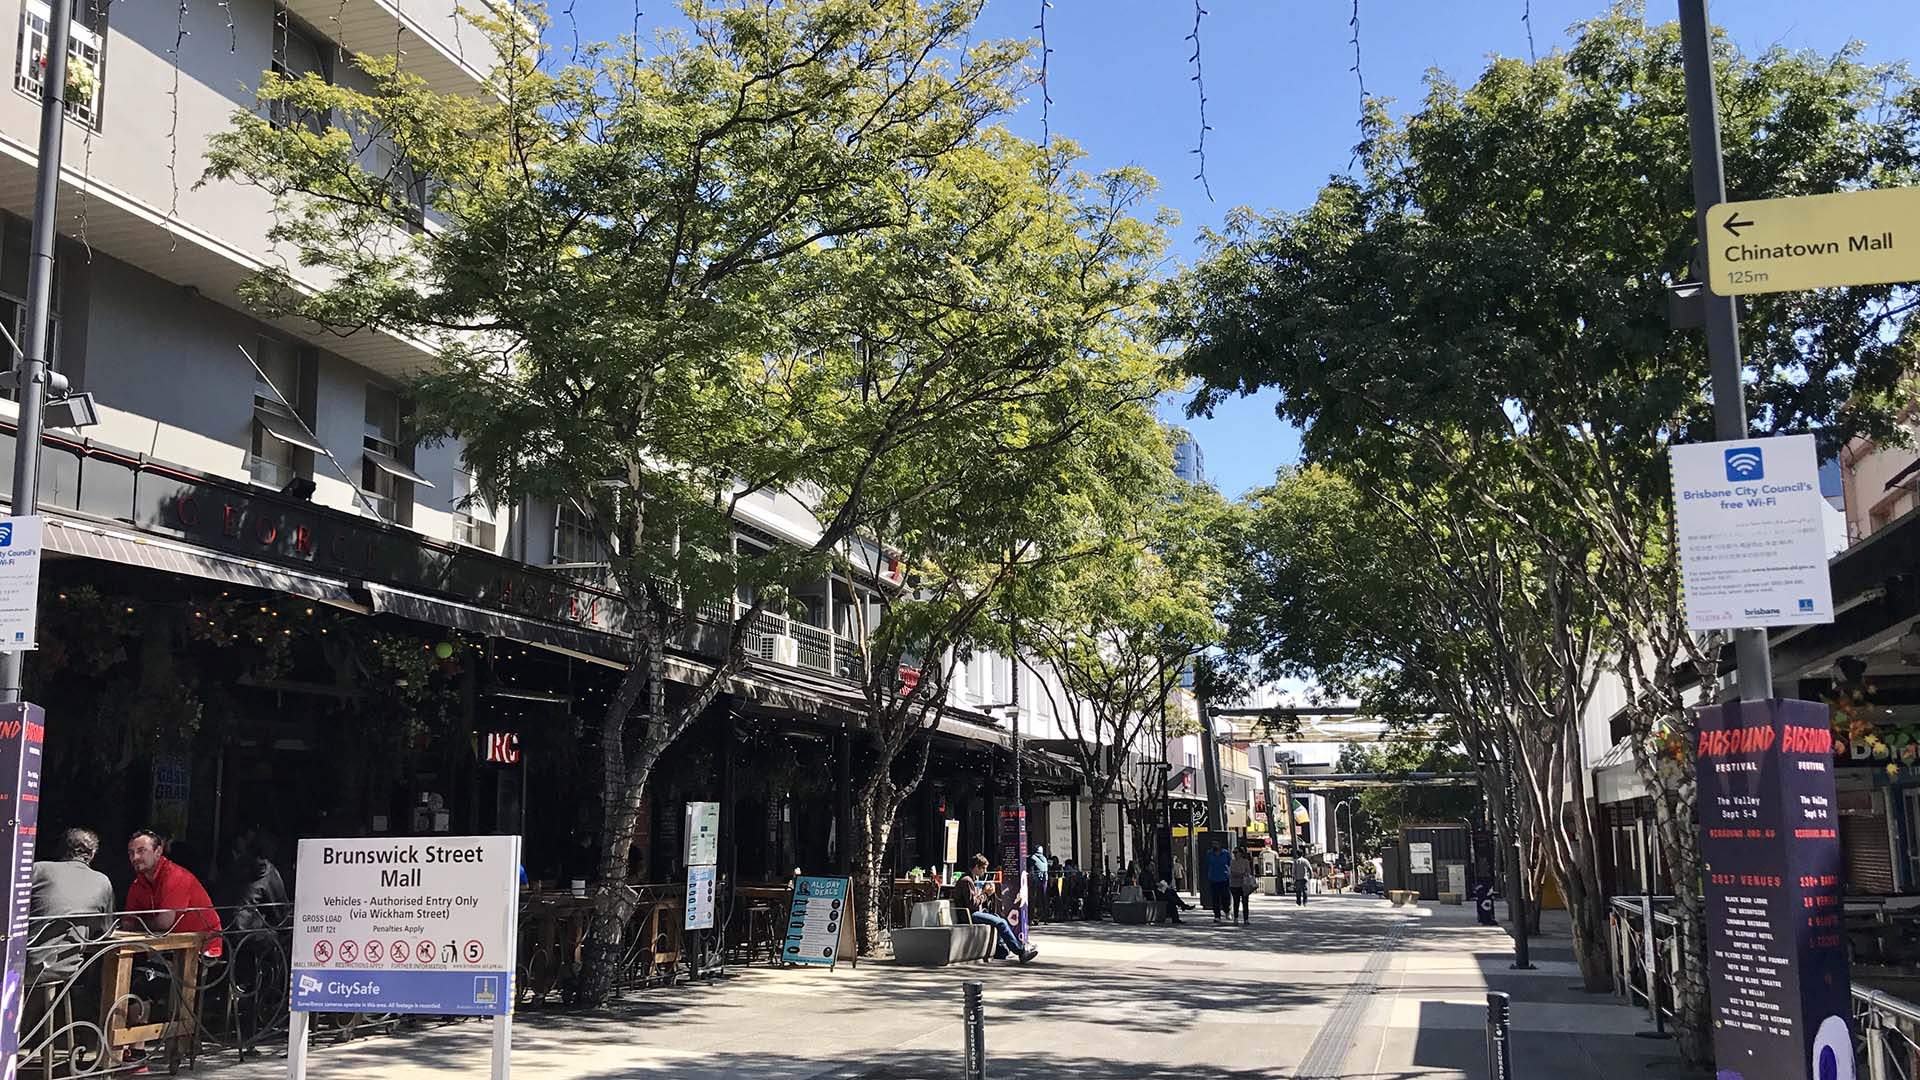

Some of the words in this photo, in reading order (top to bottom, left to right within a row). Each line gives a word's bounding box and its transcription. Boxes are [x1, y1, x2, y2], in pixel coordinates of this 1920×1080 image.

[1725, 243, 1839, 262] Chinatown
[1849, 232, 1893, 251] Mall
[1728, 271, 1768, 284] 125m
[1683, 489, 1732, 500] Brisbane
[1735, 487, 1758, 497] City
[1762, 482, 1813, 494] Council's
[1720, 501, 1743, 509] free
[1747, 497, 1777, 507] Wi-Fi
[1744, 608, 1780, 616] brisbane
[1697, 725, 1775, 756] BIGSOUND
[1782, 725, 1831, 753] BIGSOUND
[1715, 762, 1757, 772] FESTIVAL
[1798, 762, 1825, 771] FESTIVAL
[1717, 797, 1730, 805] The
[1733, 797, 1760, 806] Valley
[1800, 795, 1811, 804] The
[1812, 796, 1828, 806] Valley
[1721, 810, 1739, 820] Sept
[1743, 809, 1757, 818] 5-8
[1804, 810, 1816, 820] Sept
[323, 845, 418, 865] Brunswick
[426, 845, 483, 864] Street
[381, 868, 421, 888] Mall
[1712, 875, 1736, 885] 2017
[1741, 875, 1782, 888] VENUES
[814, 888, 838, 896] DEALS
[324, 897, 361, 906] Vehicles
[370, 896, 422, 906] Authorised
[425, 896, 452, 908] Entry
[455, 896, 479, 908] Only
[302, 915, 324, 923] GROSS
[325, 915, 343, 923] LOAD
[349, 909, 367, 921] (via
[369, 909, 414, 919] Wickham
[417, 909, 450, 920] Street)
[307, 925, 324, 934] LIMIT
[326, 925, 336, 934] 12t
[373, 925, 403, 934] Penalties
[404, 925, 424, 935] Apply
[469, 945, 479, 958] 5
[328, 981, 380, 998] CitySafe
